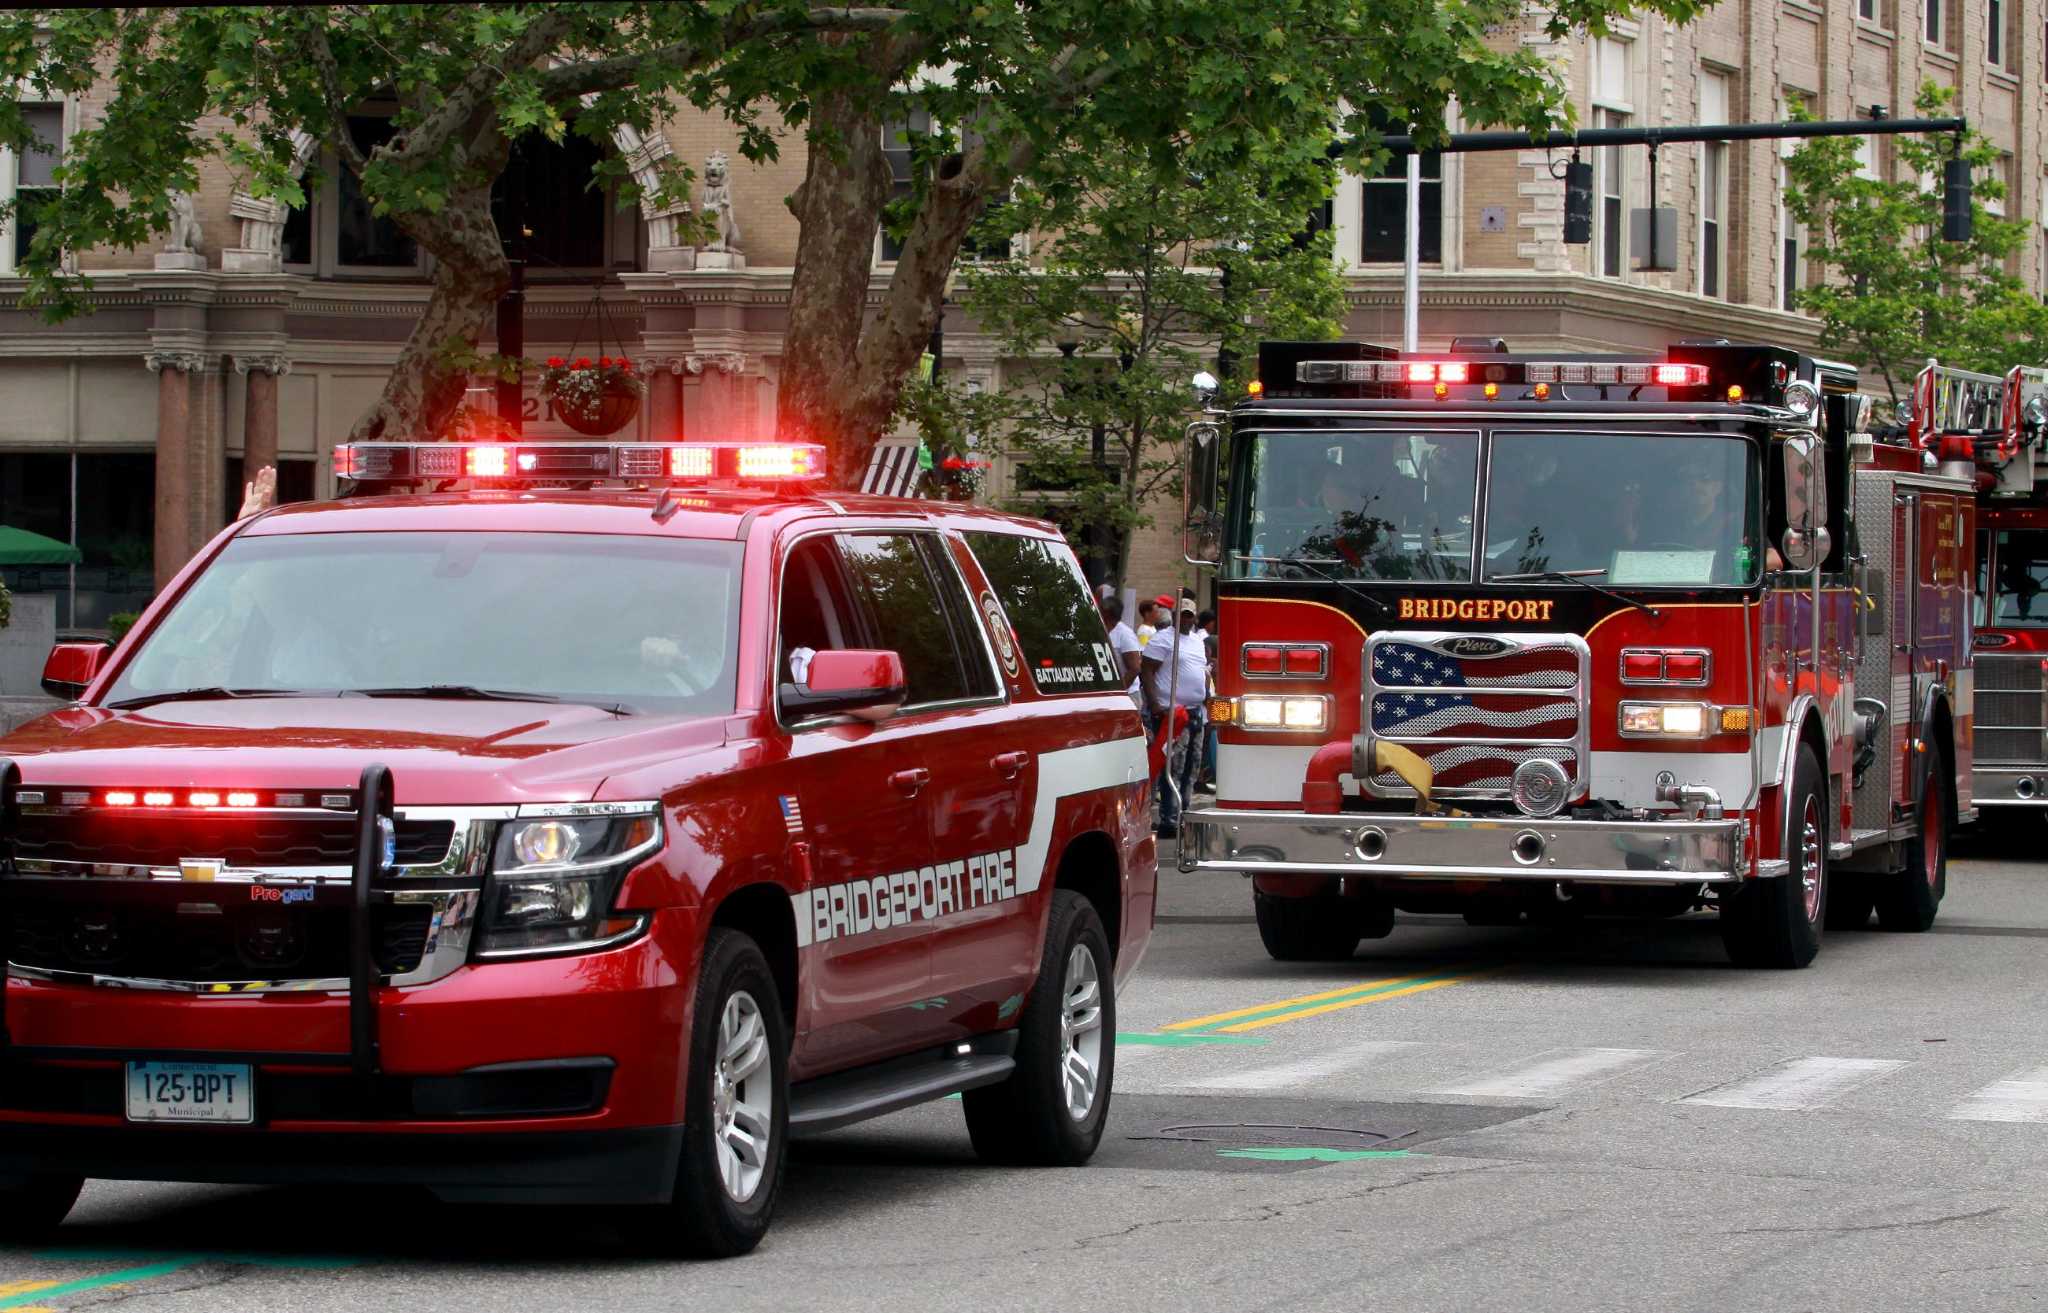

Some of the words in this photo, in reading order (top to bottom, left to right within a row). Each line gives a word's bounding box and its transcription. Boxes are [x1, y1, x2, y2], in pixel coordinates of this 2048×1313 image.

[1399, 598, 1554, 621] BRIDGEPORT
[1454, 638, 1499, 654] Pierce
[1092, 642, 1120, 681] B1
[1035, 667, 1077, 683] BATTALION
[813, 860, 965, 943] BRIDGEPORT
[968, 849, 1015, 908] FIRE
[167, 1105, 214, 1117] Municipal
